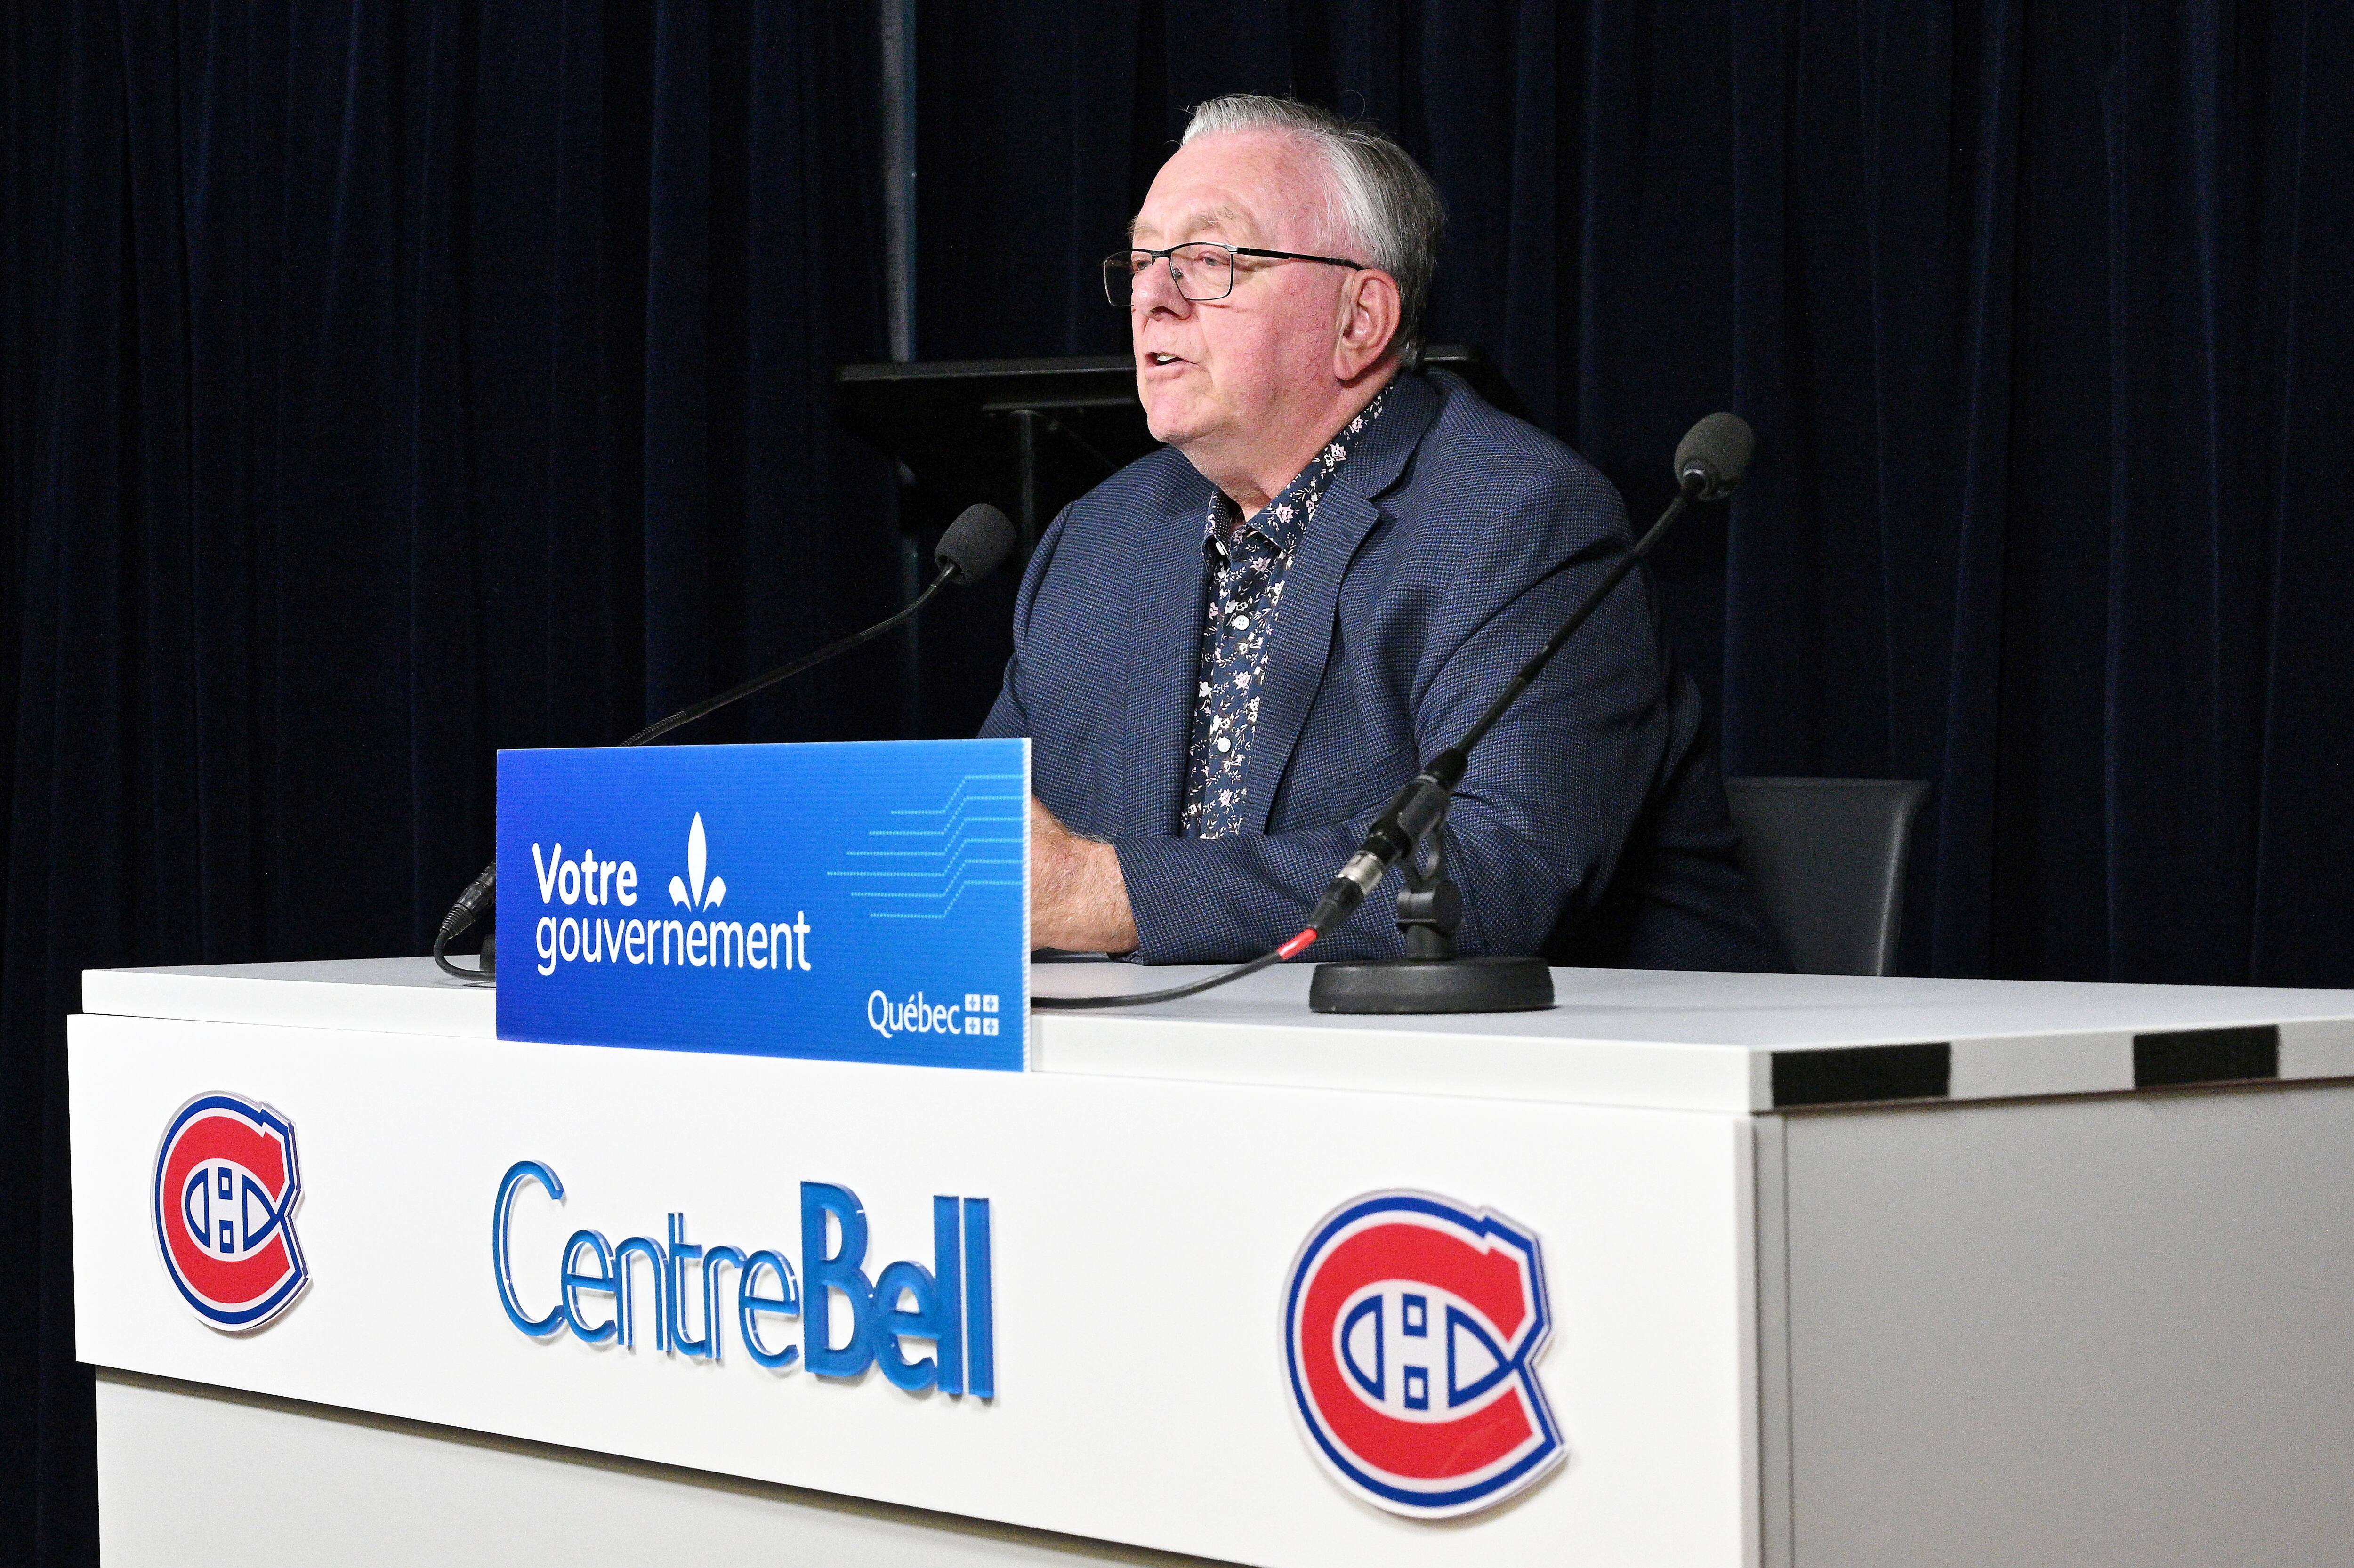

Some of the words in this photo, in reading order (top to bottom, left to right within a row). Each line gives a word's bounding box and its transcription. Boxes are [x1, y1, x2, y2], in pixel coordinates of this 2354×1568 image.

[532, 842, 637, 907] Votre
[535, 909, 812, 977] gouvernement
[867, 989, 961, 1039] Québec
